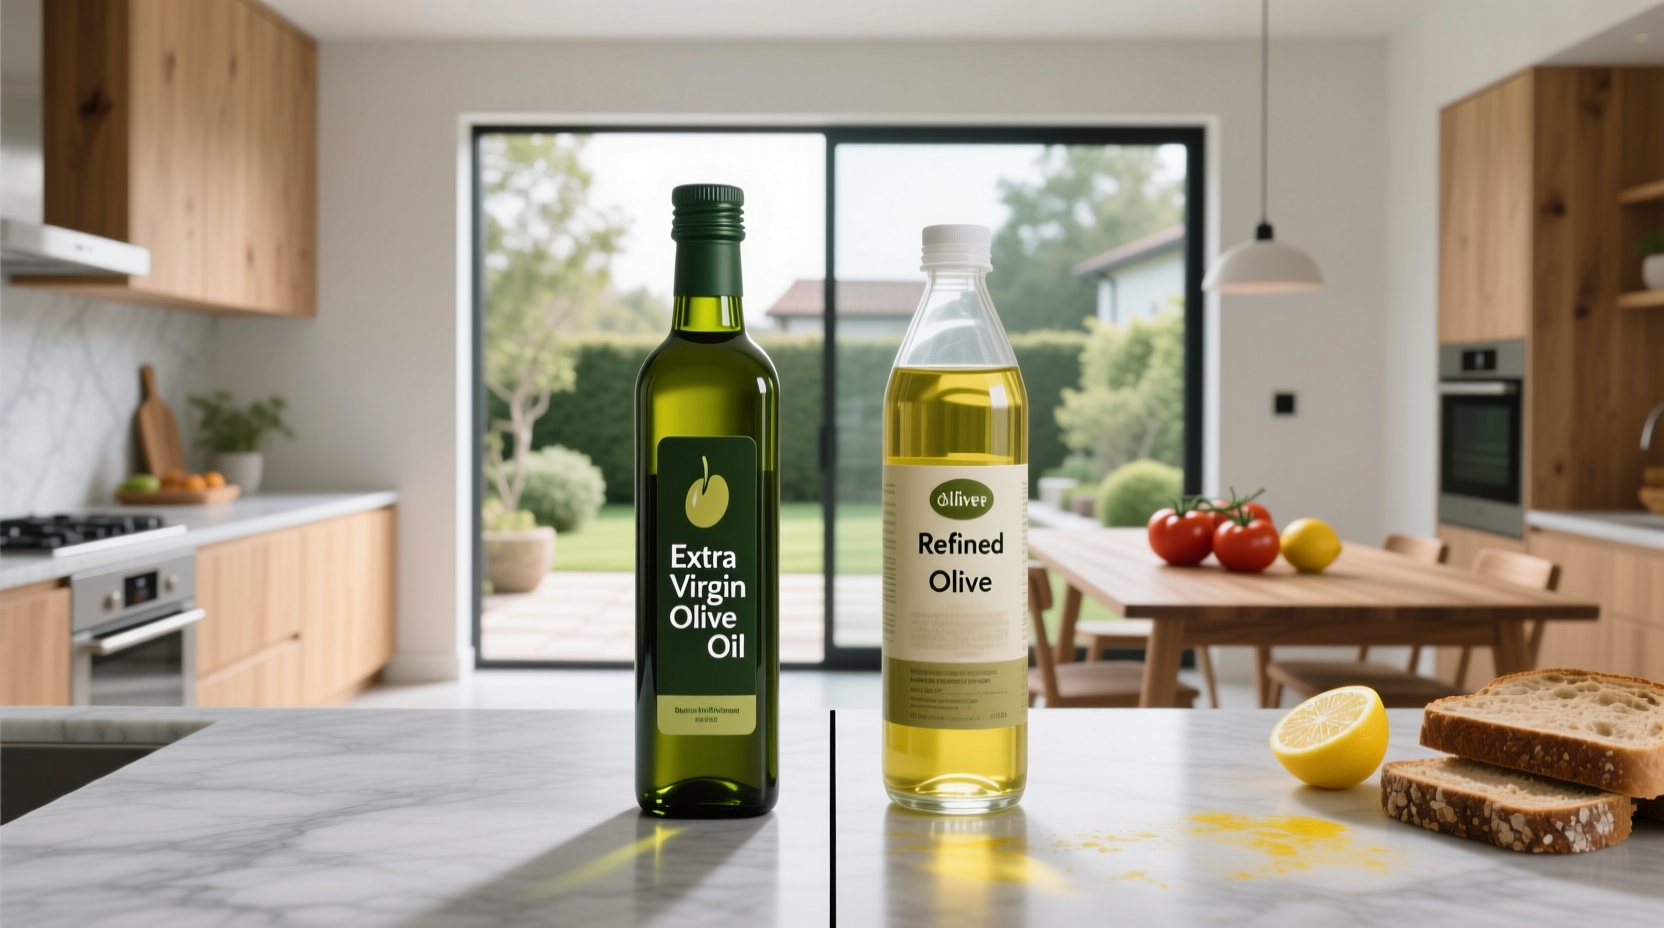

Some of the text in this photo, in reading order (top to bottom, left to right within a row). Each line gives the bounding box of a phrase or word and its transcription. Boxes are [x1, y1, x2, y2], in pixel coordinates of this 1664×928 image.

[671, 543, 737, 569] Extra
[918, 532, 1004, 555] Refined
[669, 574, 746, 606] Virgin
[928, 569, 993, 593] Olive
[669, 604, 737, 630] Olive
[707, 633, 745, 659] Oil
